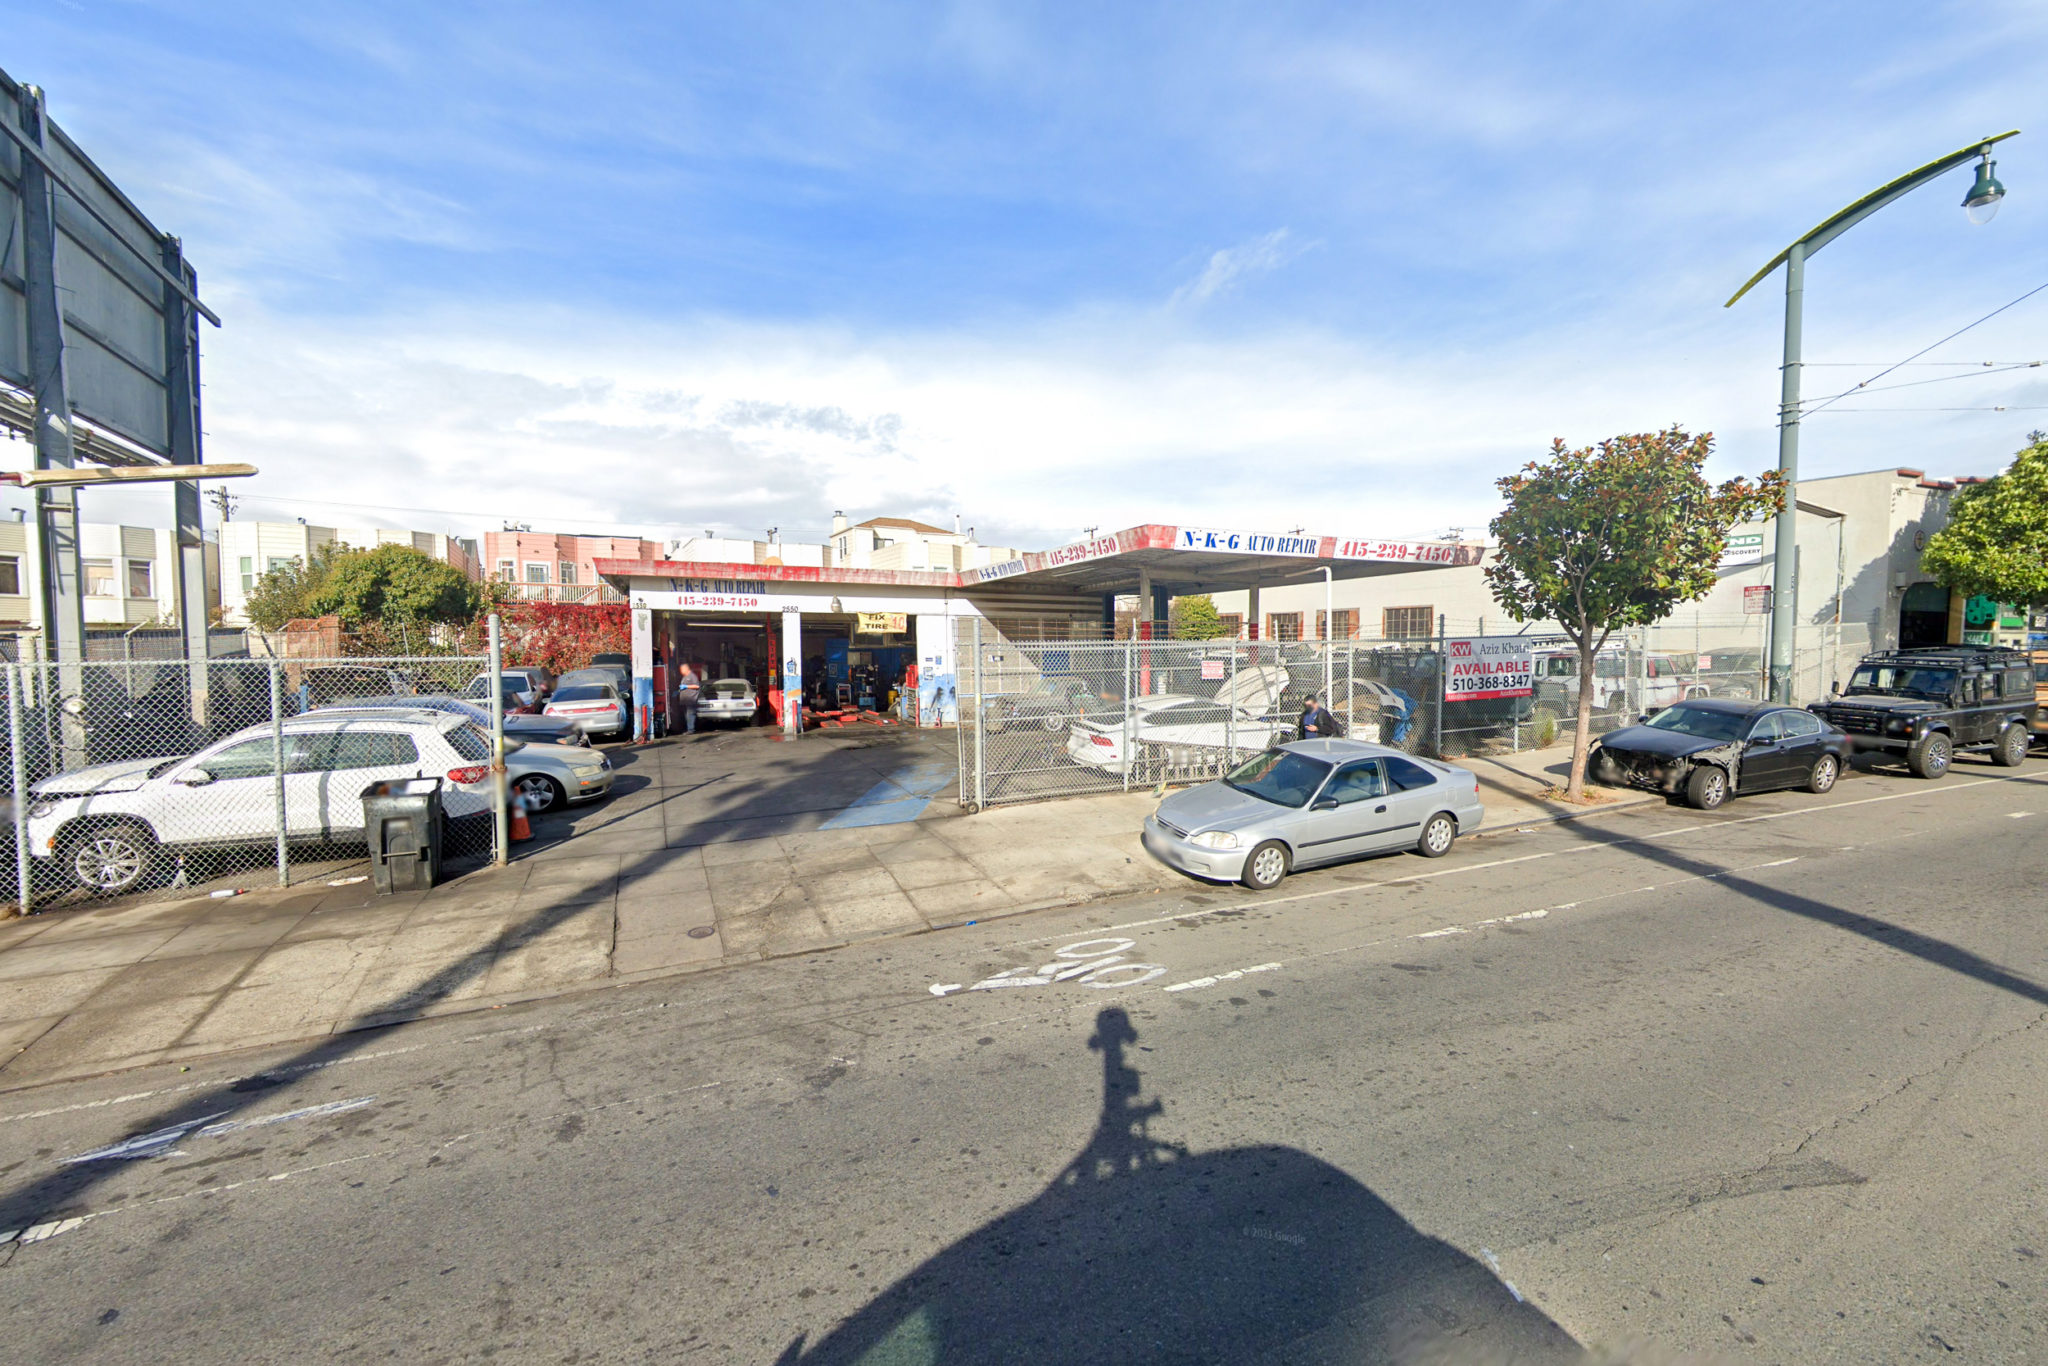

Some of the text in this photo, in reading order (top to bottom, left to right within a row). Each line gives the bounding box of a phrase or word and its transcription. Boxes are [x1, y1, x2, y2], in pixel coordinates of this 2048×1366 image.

[1183, 531, 1317, 554] N-K-G AUTO REPAIR
[1340, 541, 1451, 562] 415-239-7450
[670, 578, 766, 594] N-K-G AUTO REPAIR
[1450, 645, 1471, 656] KW
[1480, 644, 1500, 655] Aziz
[1453, 661, 1530, 676] AVAILABLE
[1453, 675, 1530, 691] 510-368-8347
